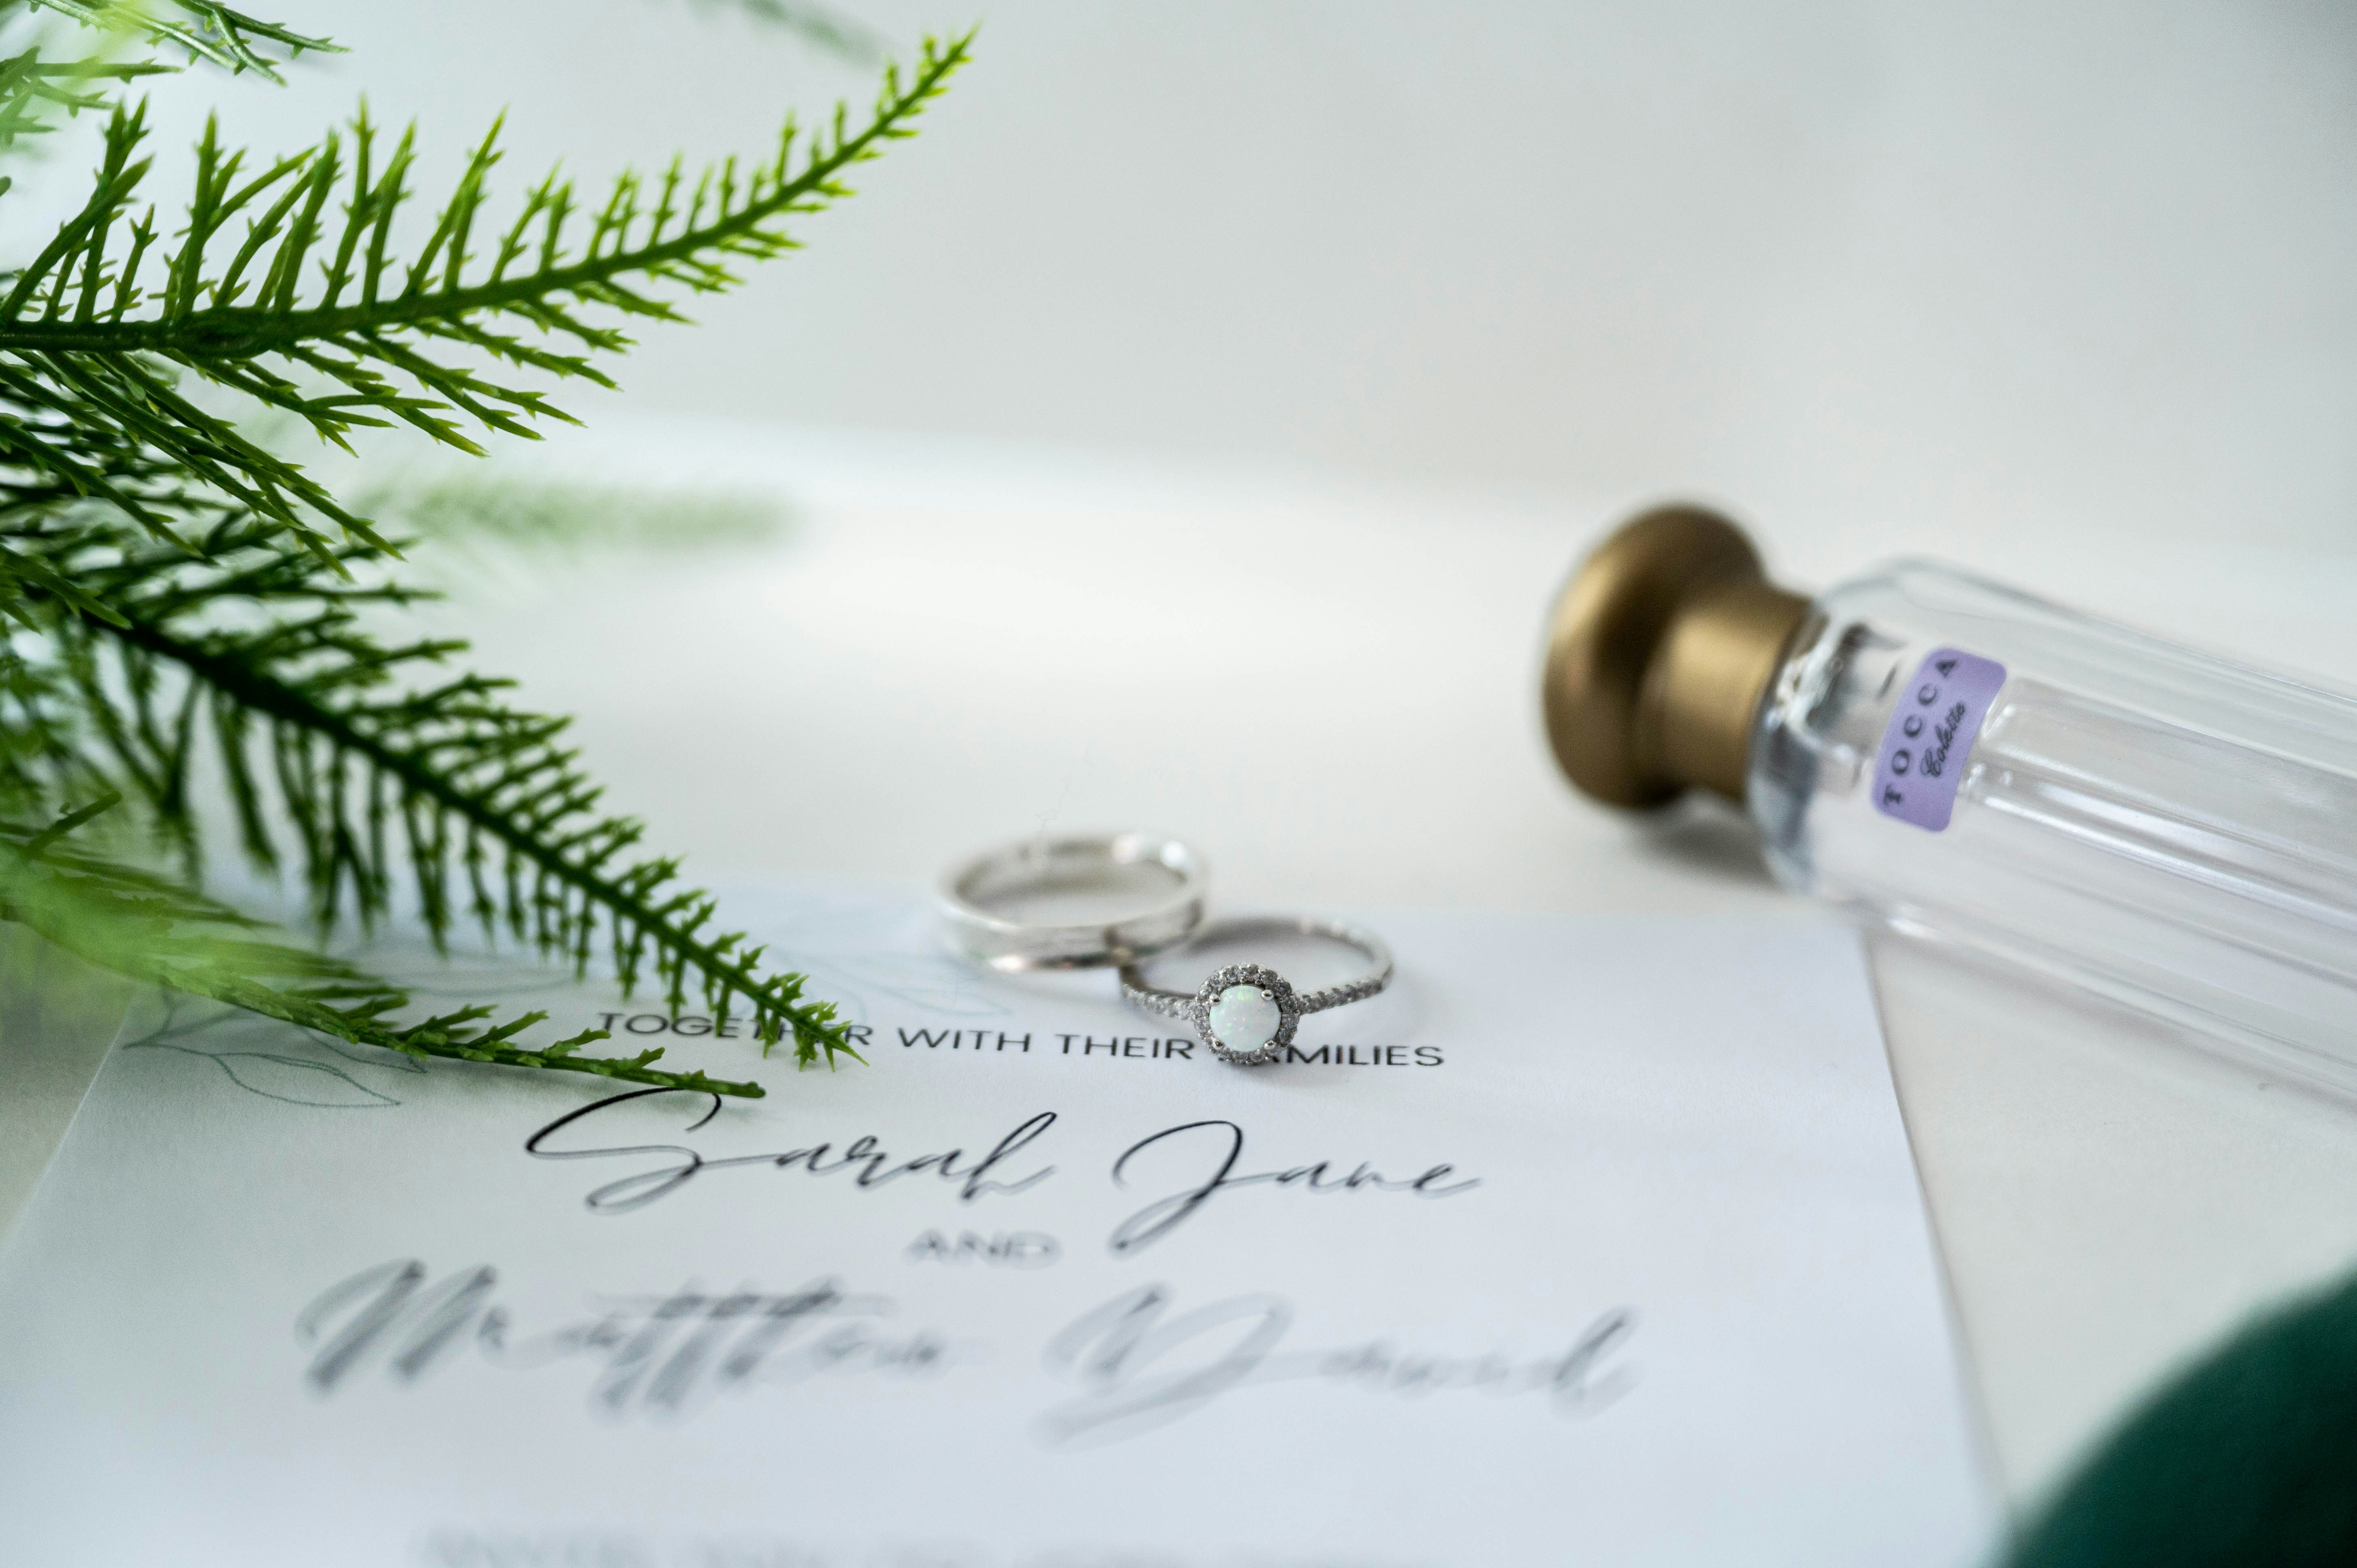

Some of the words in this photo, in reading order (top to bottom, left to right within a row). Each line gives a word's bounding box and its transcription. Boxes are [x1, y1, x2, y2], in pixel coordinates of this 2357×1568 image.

[1882, 657, 1958, 806] TOCCA
[1919, 701, 1966, 779] Colette
[599, 1012, 873, 1046] TOGETHR
[897, 1027, 1032, 1053] WITH
[1055, 1033, 1194, 1060] THEIR
[1217, 1043, 1445, 1067] MILIES
[526, 1086, 1058, 1215] Sarah
[1106, 1120, 1483, 1259] Jane
[907, 1229, 1061, 1268] AND
[1029, 1281, 1641, 1452] David
